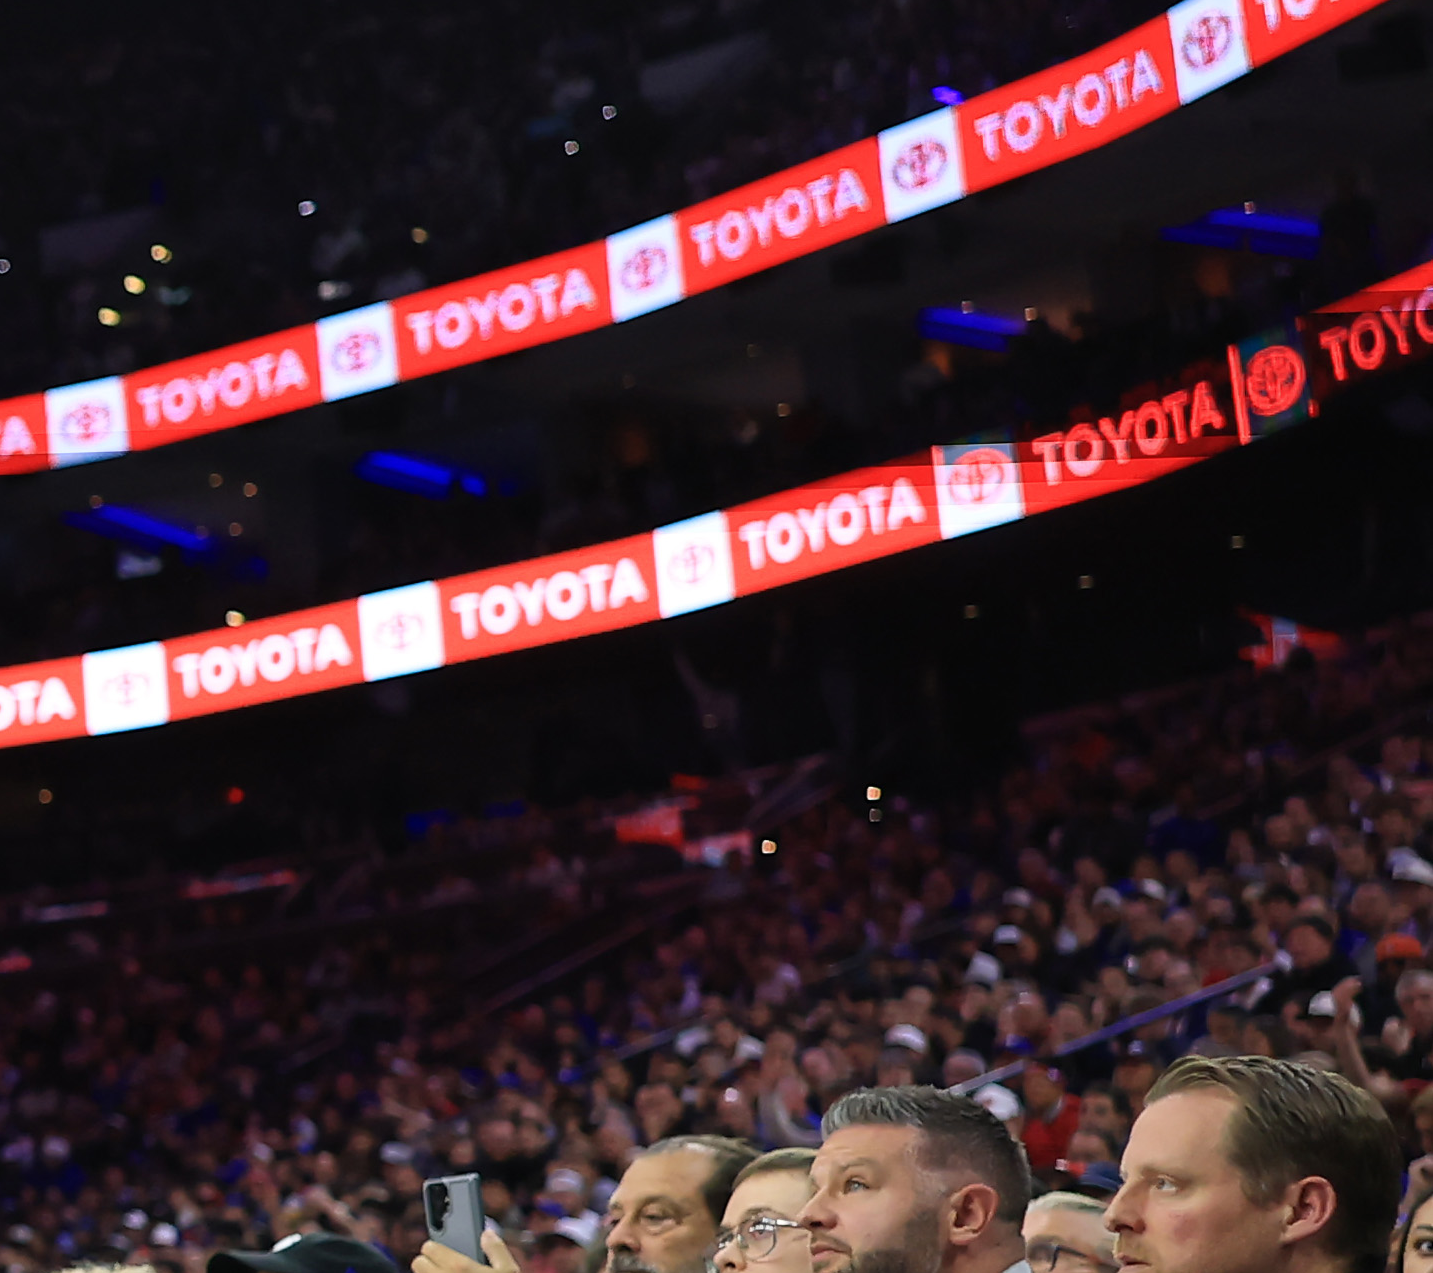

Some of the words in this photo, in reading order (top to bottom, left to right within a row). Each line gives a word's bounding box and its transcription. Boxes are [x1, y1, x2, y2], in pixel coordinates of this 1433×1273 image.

[974, 49, 1164, 162] TOYOTA
[690, 168, 869, 267] TOYOTA
[406, 268, 597, 354] TOYOTA
[136, 346, 308, 427] TOYOTA
[1031, 380, 1225, 488] TOYOTA
[736, 477, 927, 571] TOYOTA
[449, 557, 649, 640] TOYOTA
[173, 621, 353, 699] TOYOTA
